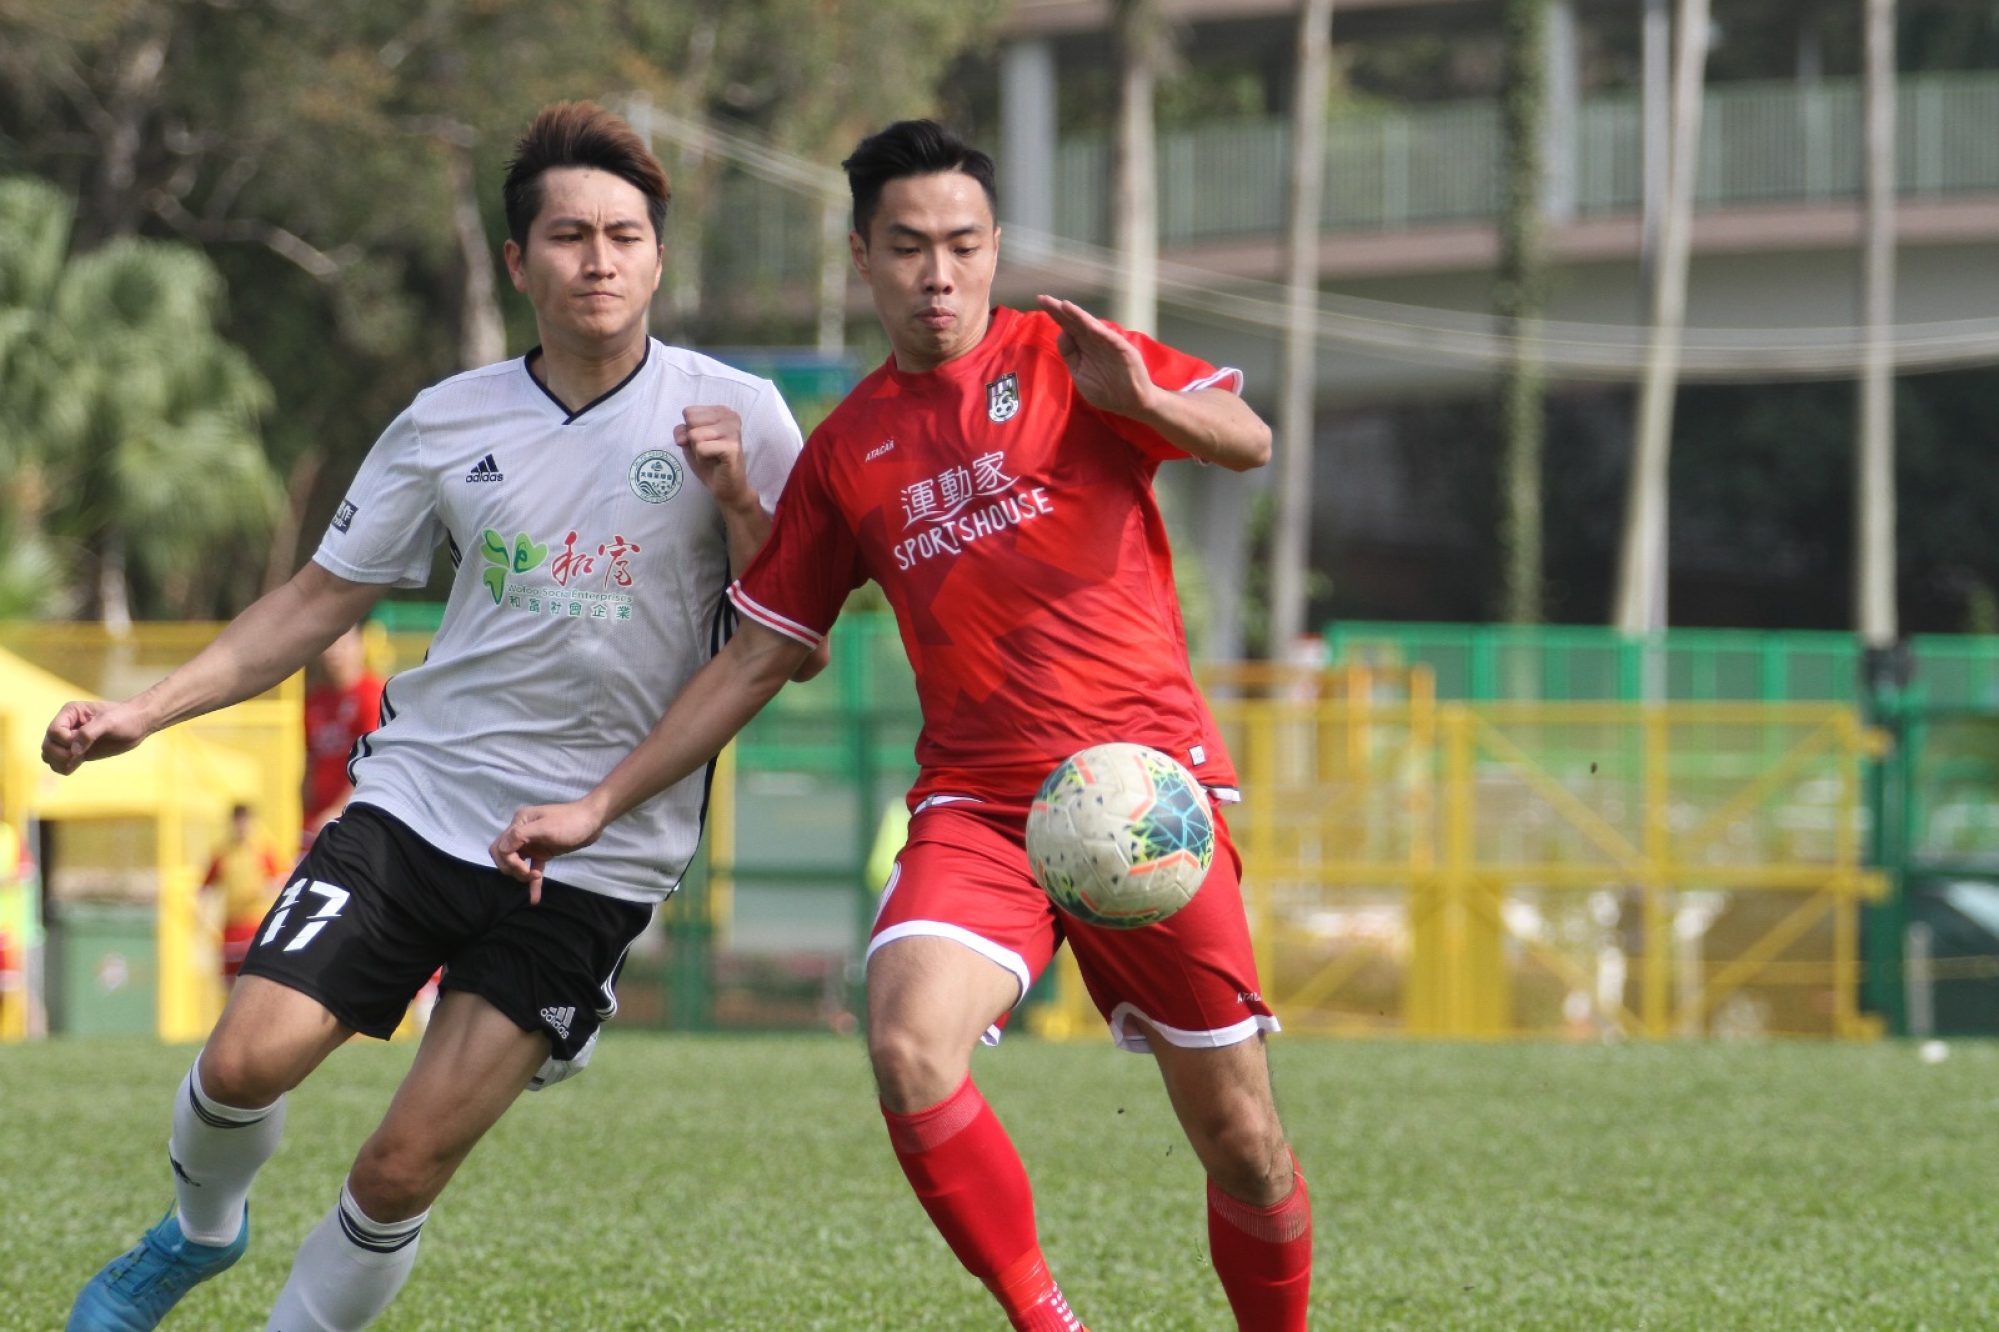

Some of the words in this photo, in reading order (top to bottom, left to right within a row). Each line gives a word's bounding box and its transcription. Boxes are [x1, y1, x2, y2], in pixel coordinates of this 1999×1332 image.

[465, 471, 504, 483] adidas
[900, 451, 1019, 530] 運動家
[893, 487, 1055, 570] SPORTSHOUSE
[260, 877, 350, 952] 17
[540, 1007, 569, 1039] adidas
